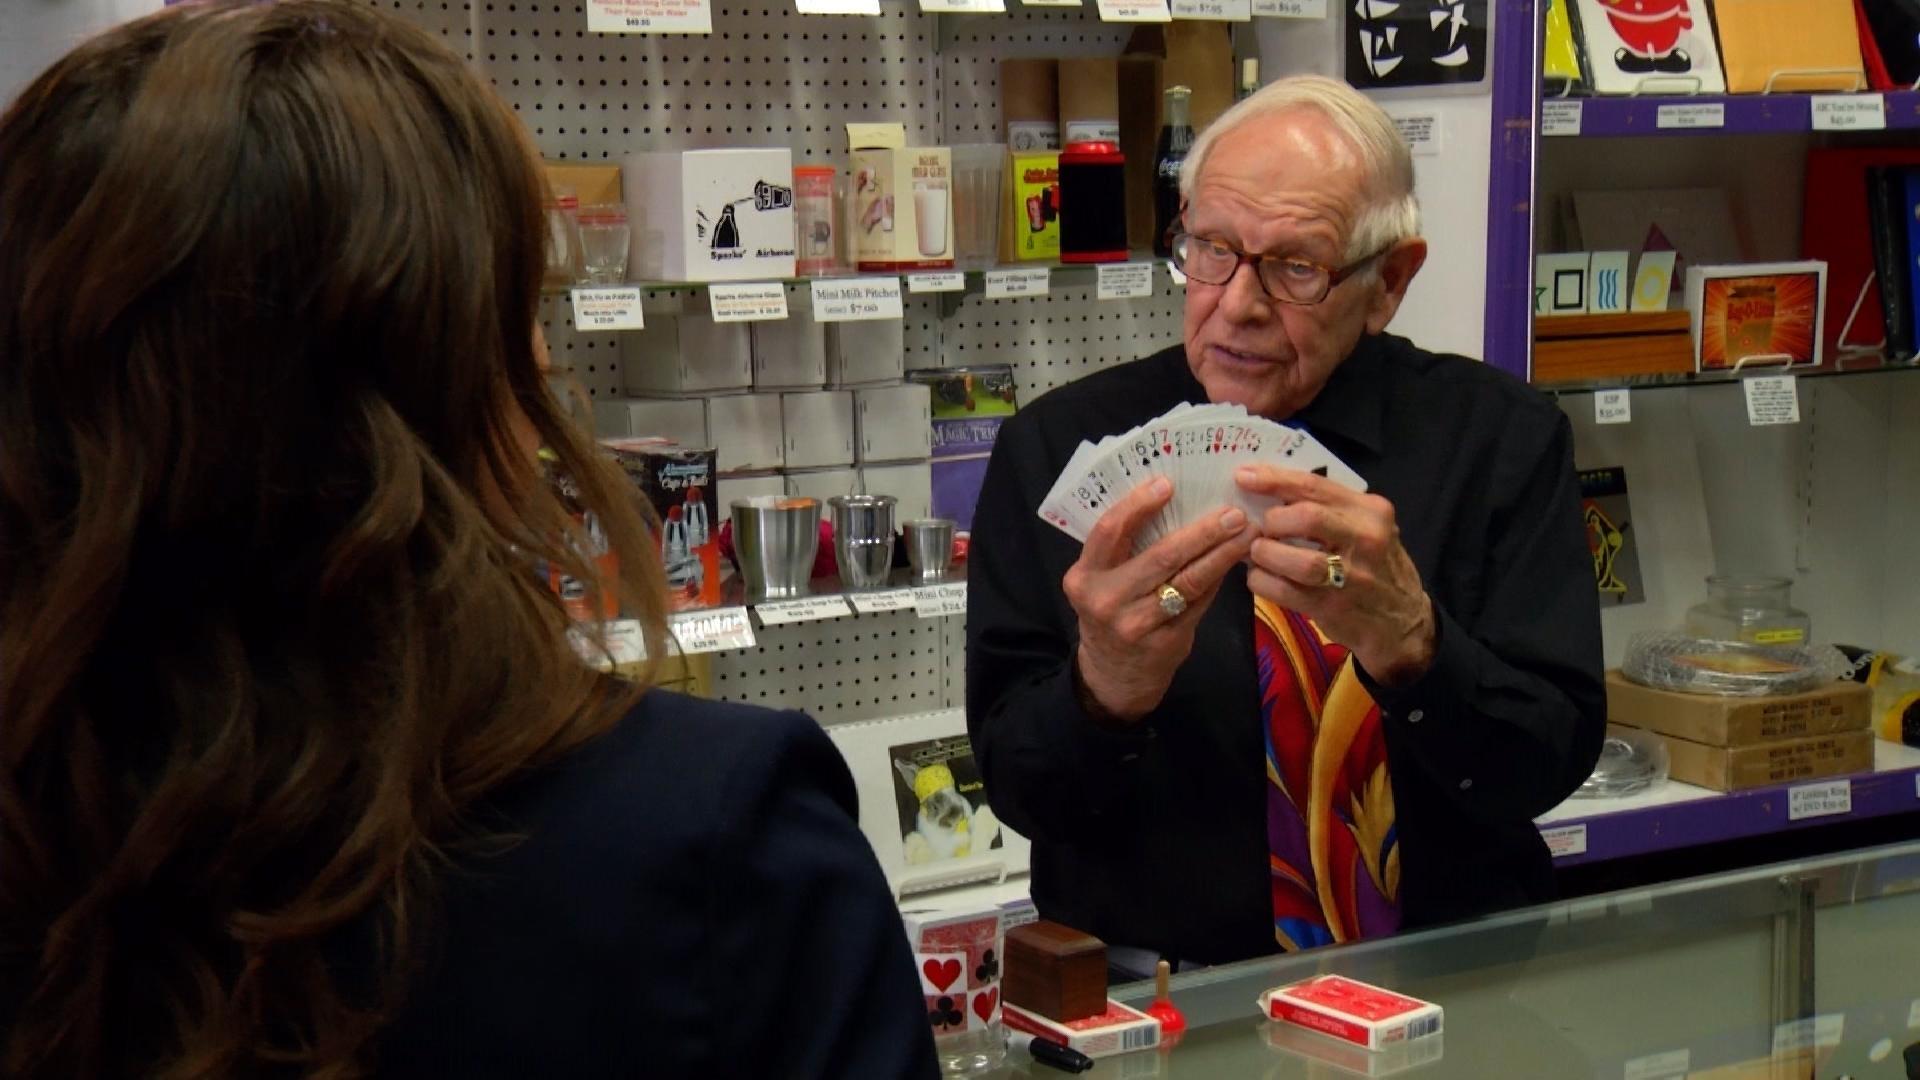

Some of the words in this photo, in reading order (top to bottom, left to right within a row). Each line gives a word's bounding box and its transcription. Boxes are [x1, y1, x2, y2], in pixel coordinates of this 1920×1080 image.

[816, 289, 839, 300] Mini
[841, 288, 863, 300] Milk
[1159, 429, 1169, 442] 7
